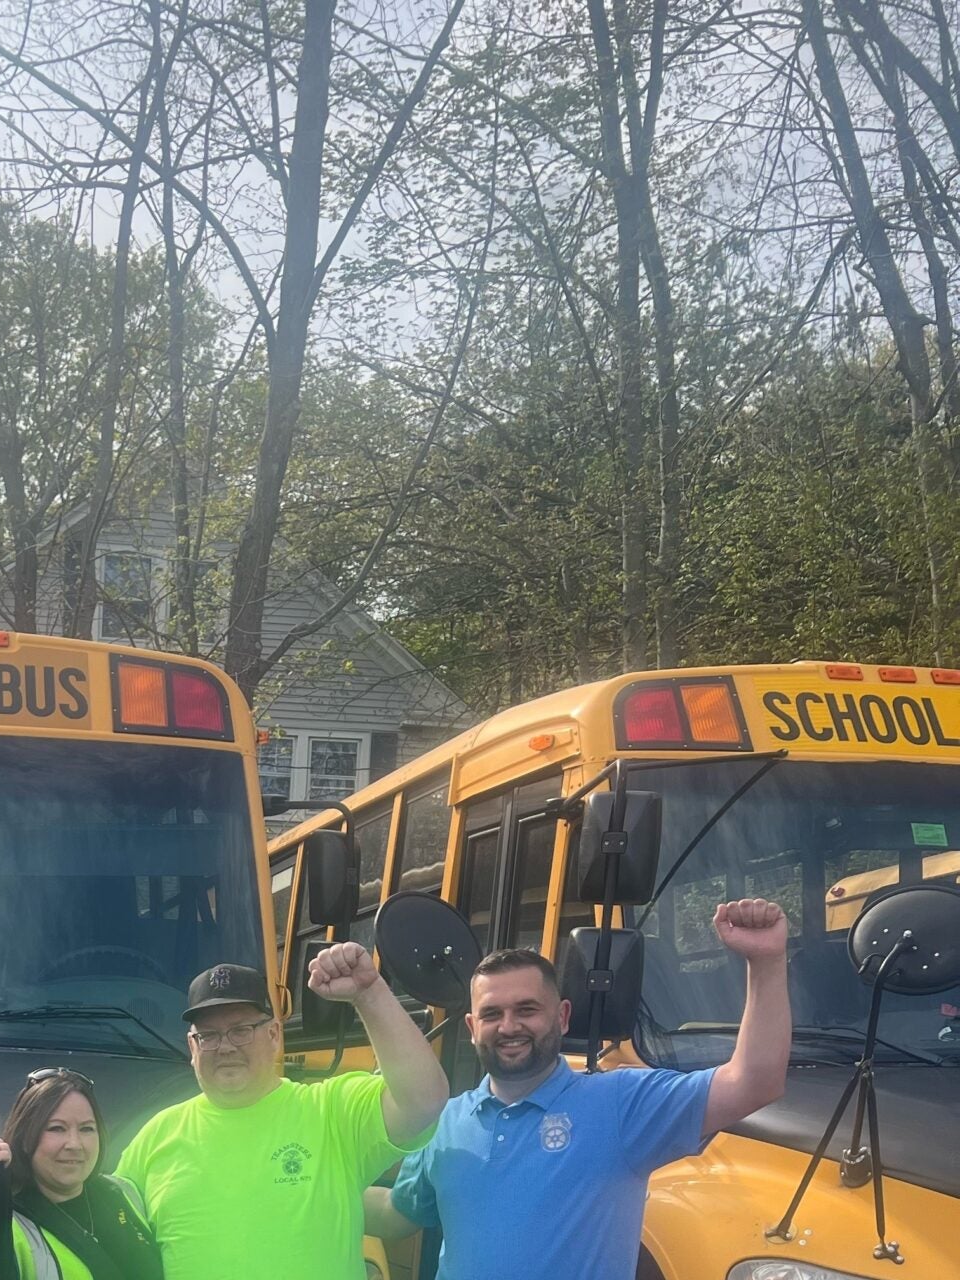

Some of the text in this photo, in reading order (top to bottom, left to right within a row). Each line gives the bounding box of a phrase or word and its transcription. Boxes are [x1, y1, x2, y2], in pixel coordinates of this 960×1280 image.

[762, 691, 960, 747] SCHOOL
[270, 1142, 312, 1161] TEAMSTERS
[274, 1176, 299, 1184] LOCAL
